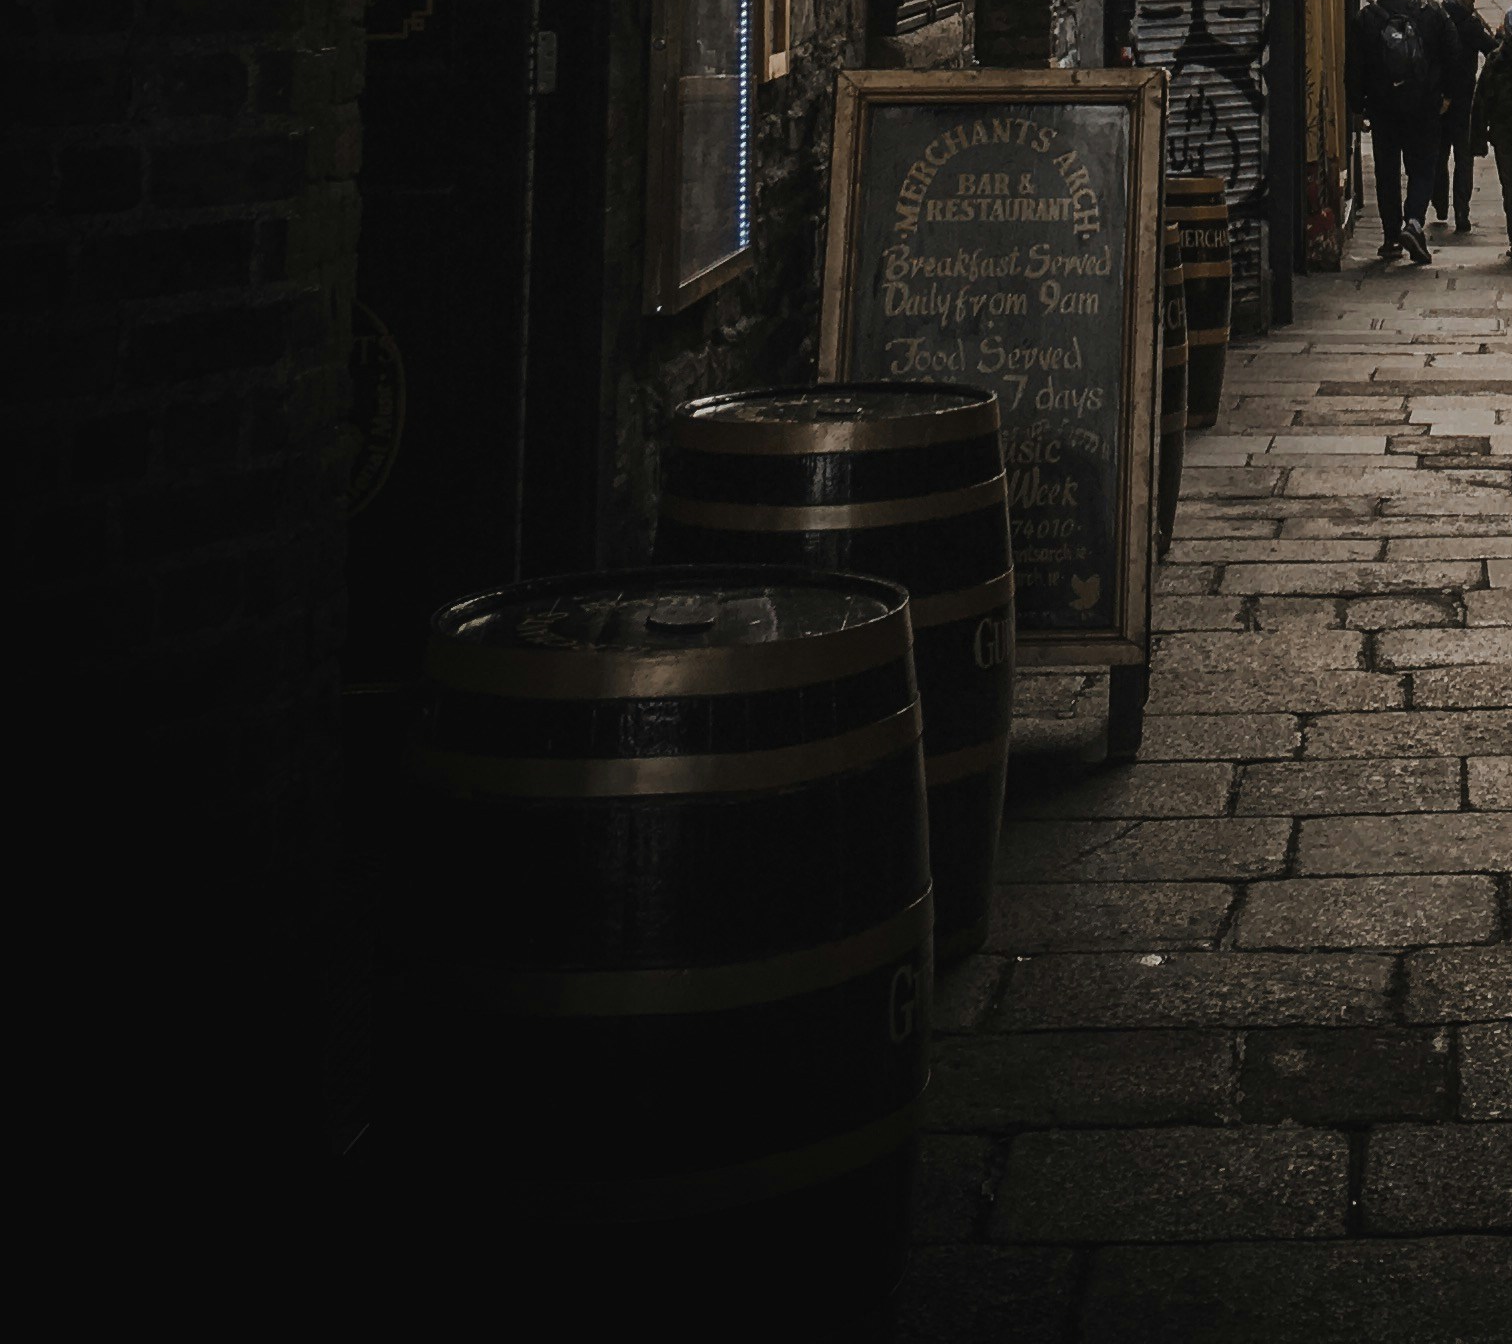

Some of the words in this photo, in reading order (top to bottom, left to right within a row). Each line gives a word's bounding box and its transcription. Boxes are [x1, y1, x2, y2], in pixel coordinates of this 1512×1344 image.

[956, 172, 1010, 195] BAR
[1018, 172, 1038, 194] &
[1053, 150, 1101, 236] ARCH
[926, 198, 1073, 223] RESTAURANT
[882, 244, 1022, 282] Breakfast
[1024, 244, 1113, 280] Served
[882, 282, 951, 329] Daily
[955, 283, 1028, 323] from
[1039, 279, 1100, 315] 9am
[885, 336, 965, 375] Food
[977, 335, 1083, 374] Served
[1003, 373, 1029, 411] 7
[1035, 374, 1104, 418] days
[1000, 435, 1062, 464] usic
[1008, 465, 1080, 510] Week
